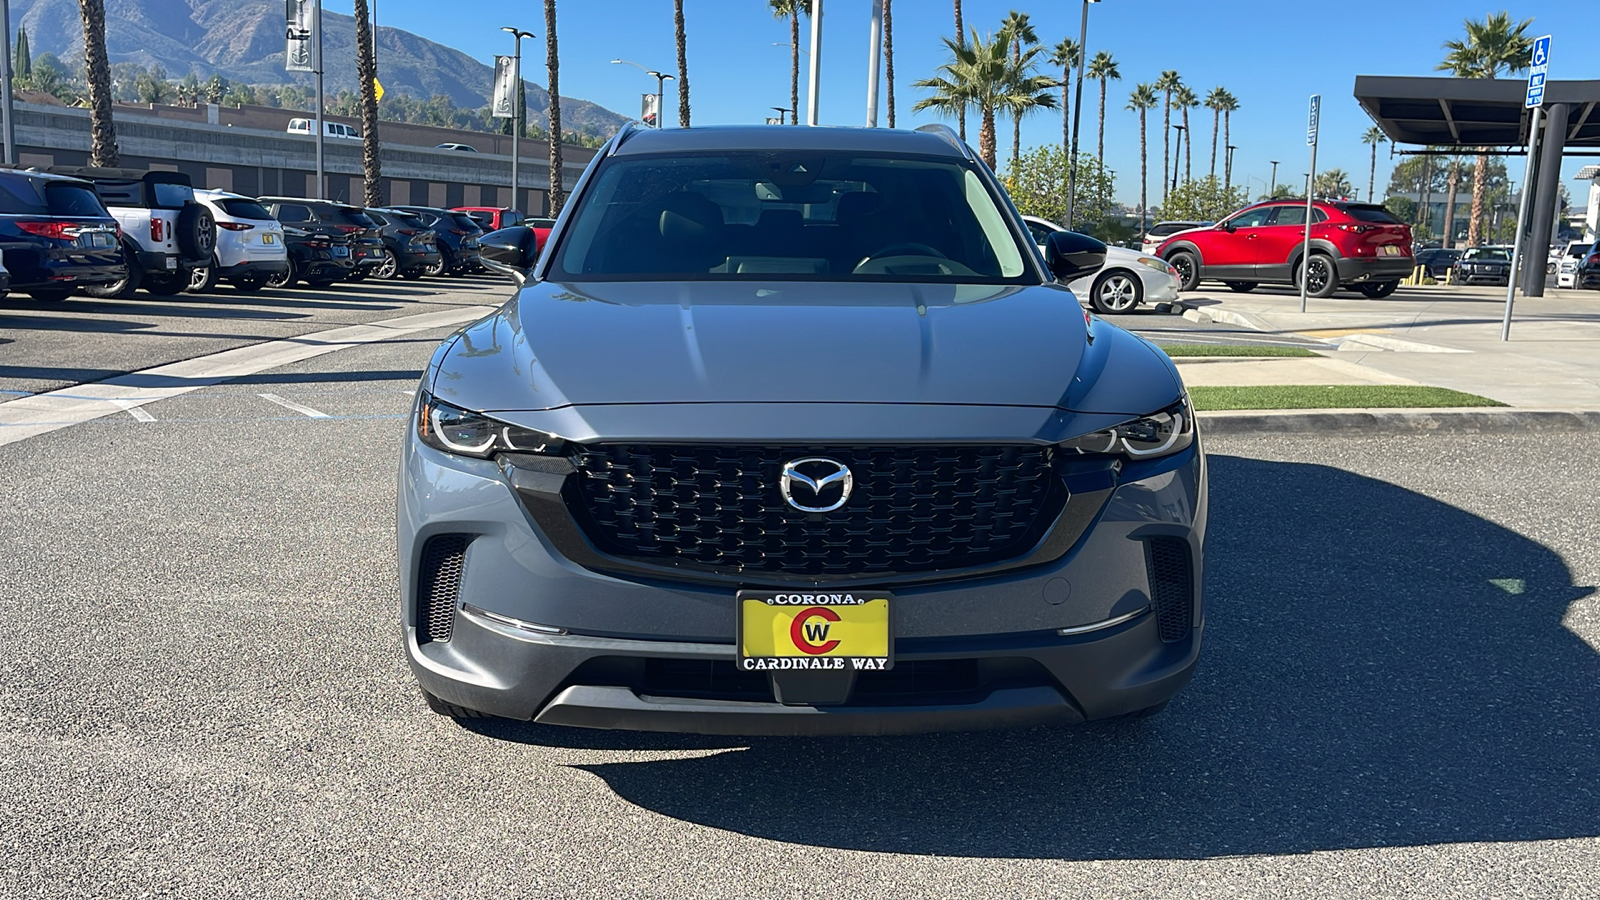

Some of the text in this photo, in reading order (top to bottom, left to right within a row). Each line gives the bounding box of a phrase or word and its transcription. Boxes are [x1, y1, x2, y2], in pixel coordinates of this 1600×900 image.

[775, 594, 855, 605] CORONA
[743, 658, 888, 670] CARDINALE WAY
